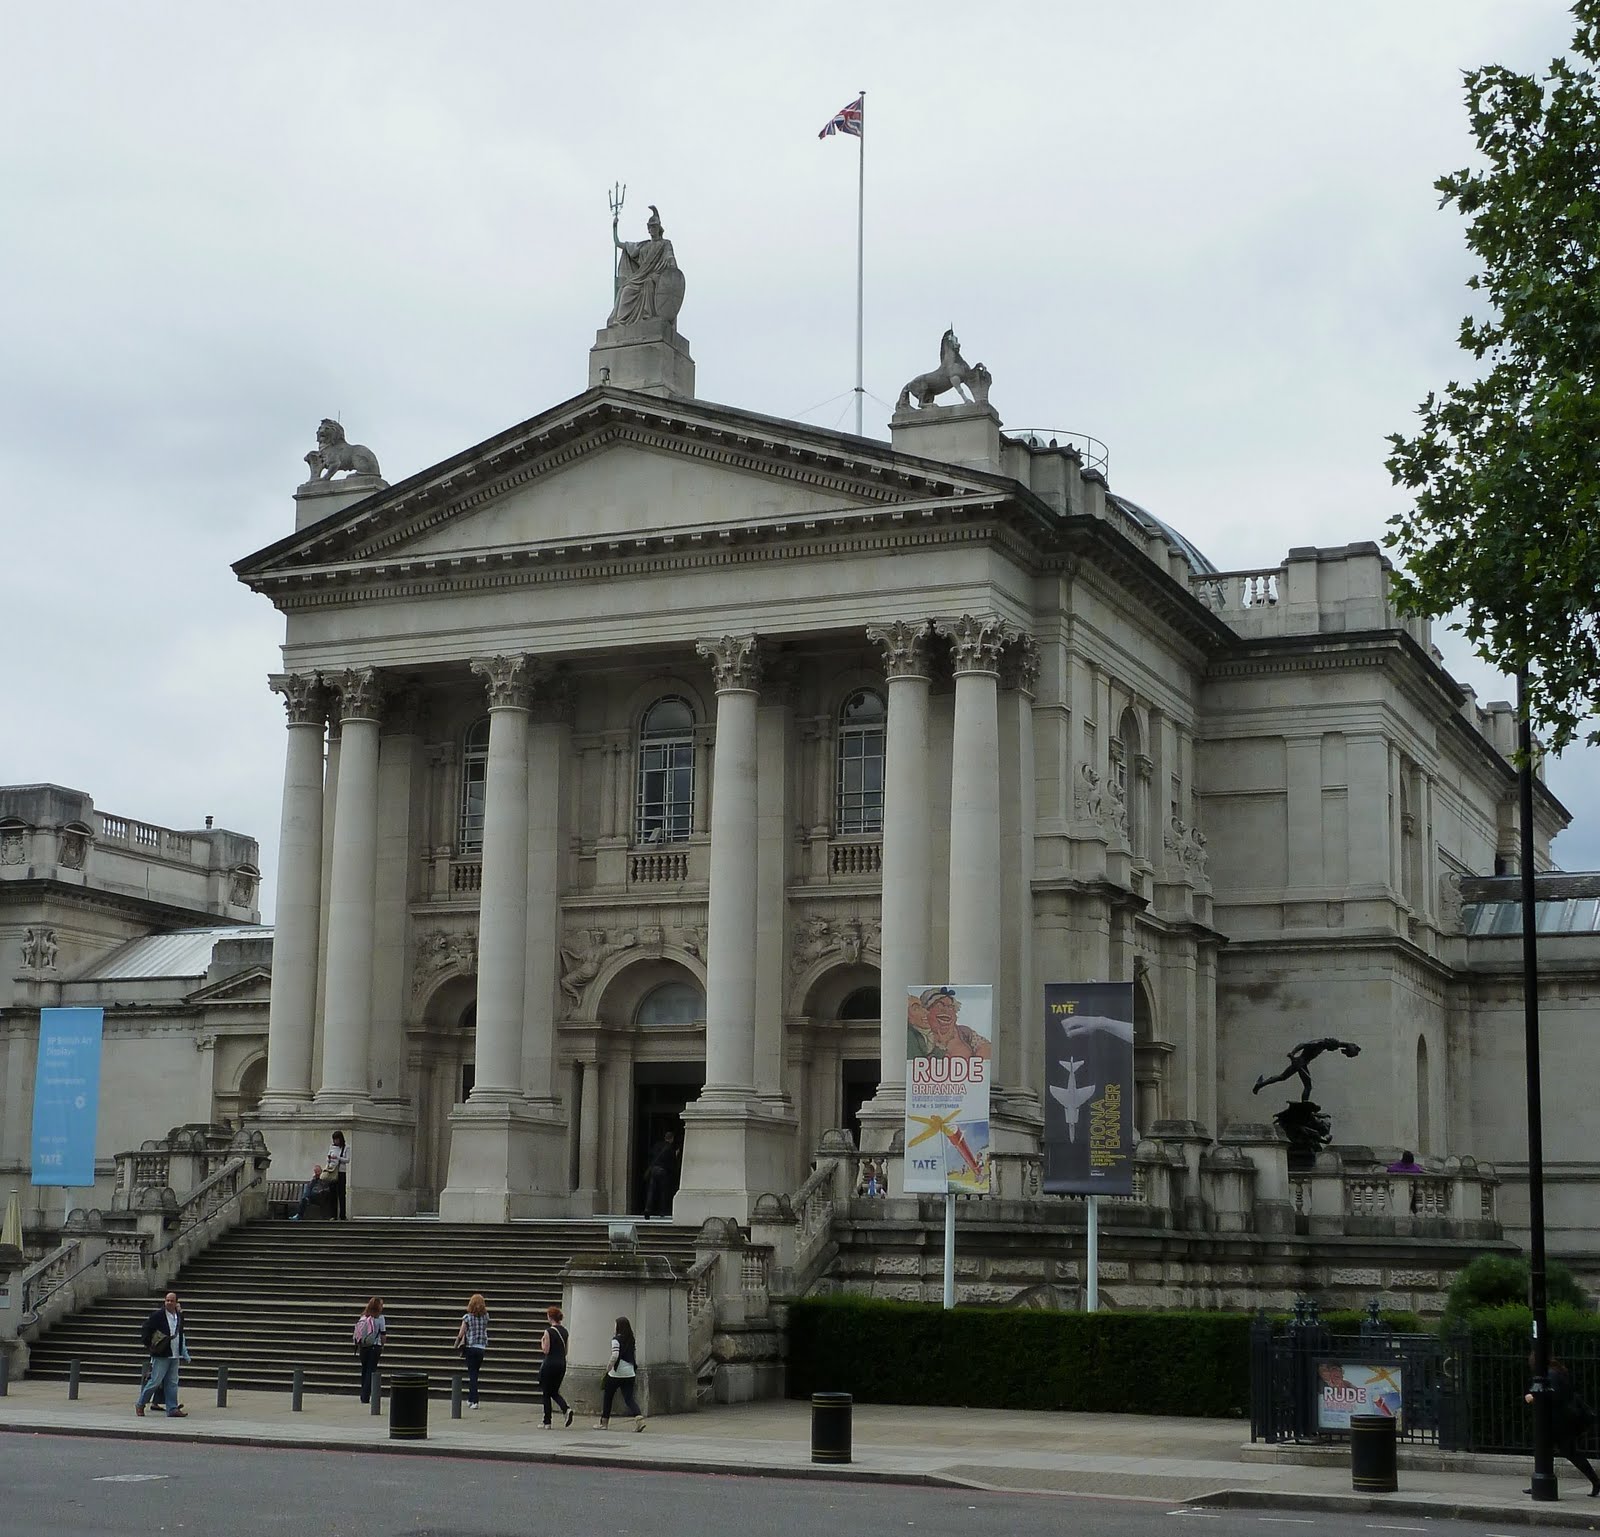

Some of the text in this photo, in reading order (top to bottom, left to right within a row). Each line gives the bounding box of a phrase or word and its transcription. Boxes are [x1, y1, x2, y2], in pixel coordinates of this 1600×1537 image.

[1050, 1004, 1074, 1014] TATE
[913, 1056, 984, 1083] RUDE
[912, 1084, 967, 1095] BRITANNIA
[1090, 1098, 1105, 1149] FIONA
[1105, 1084, 1121, 1149] BANNER
[40, 1153, 63, 1165] TATE
[912, 1159, 937, 1170] TATE
[1323, 1386, 1366, 1404] RUDE
